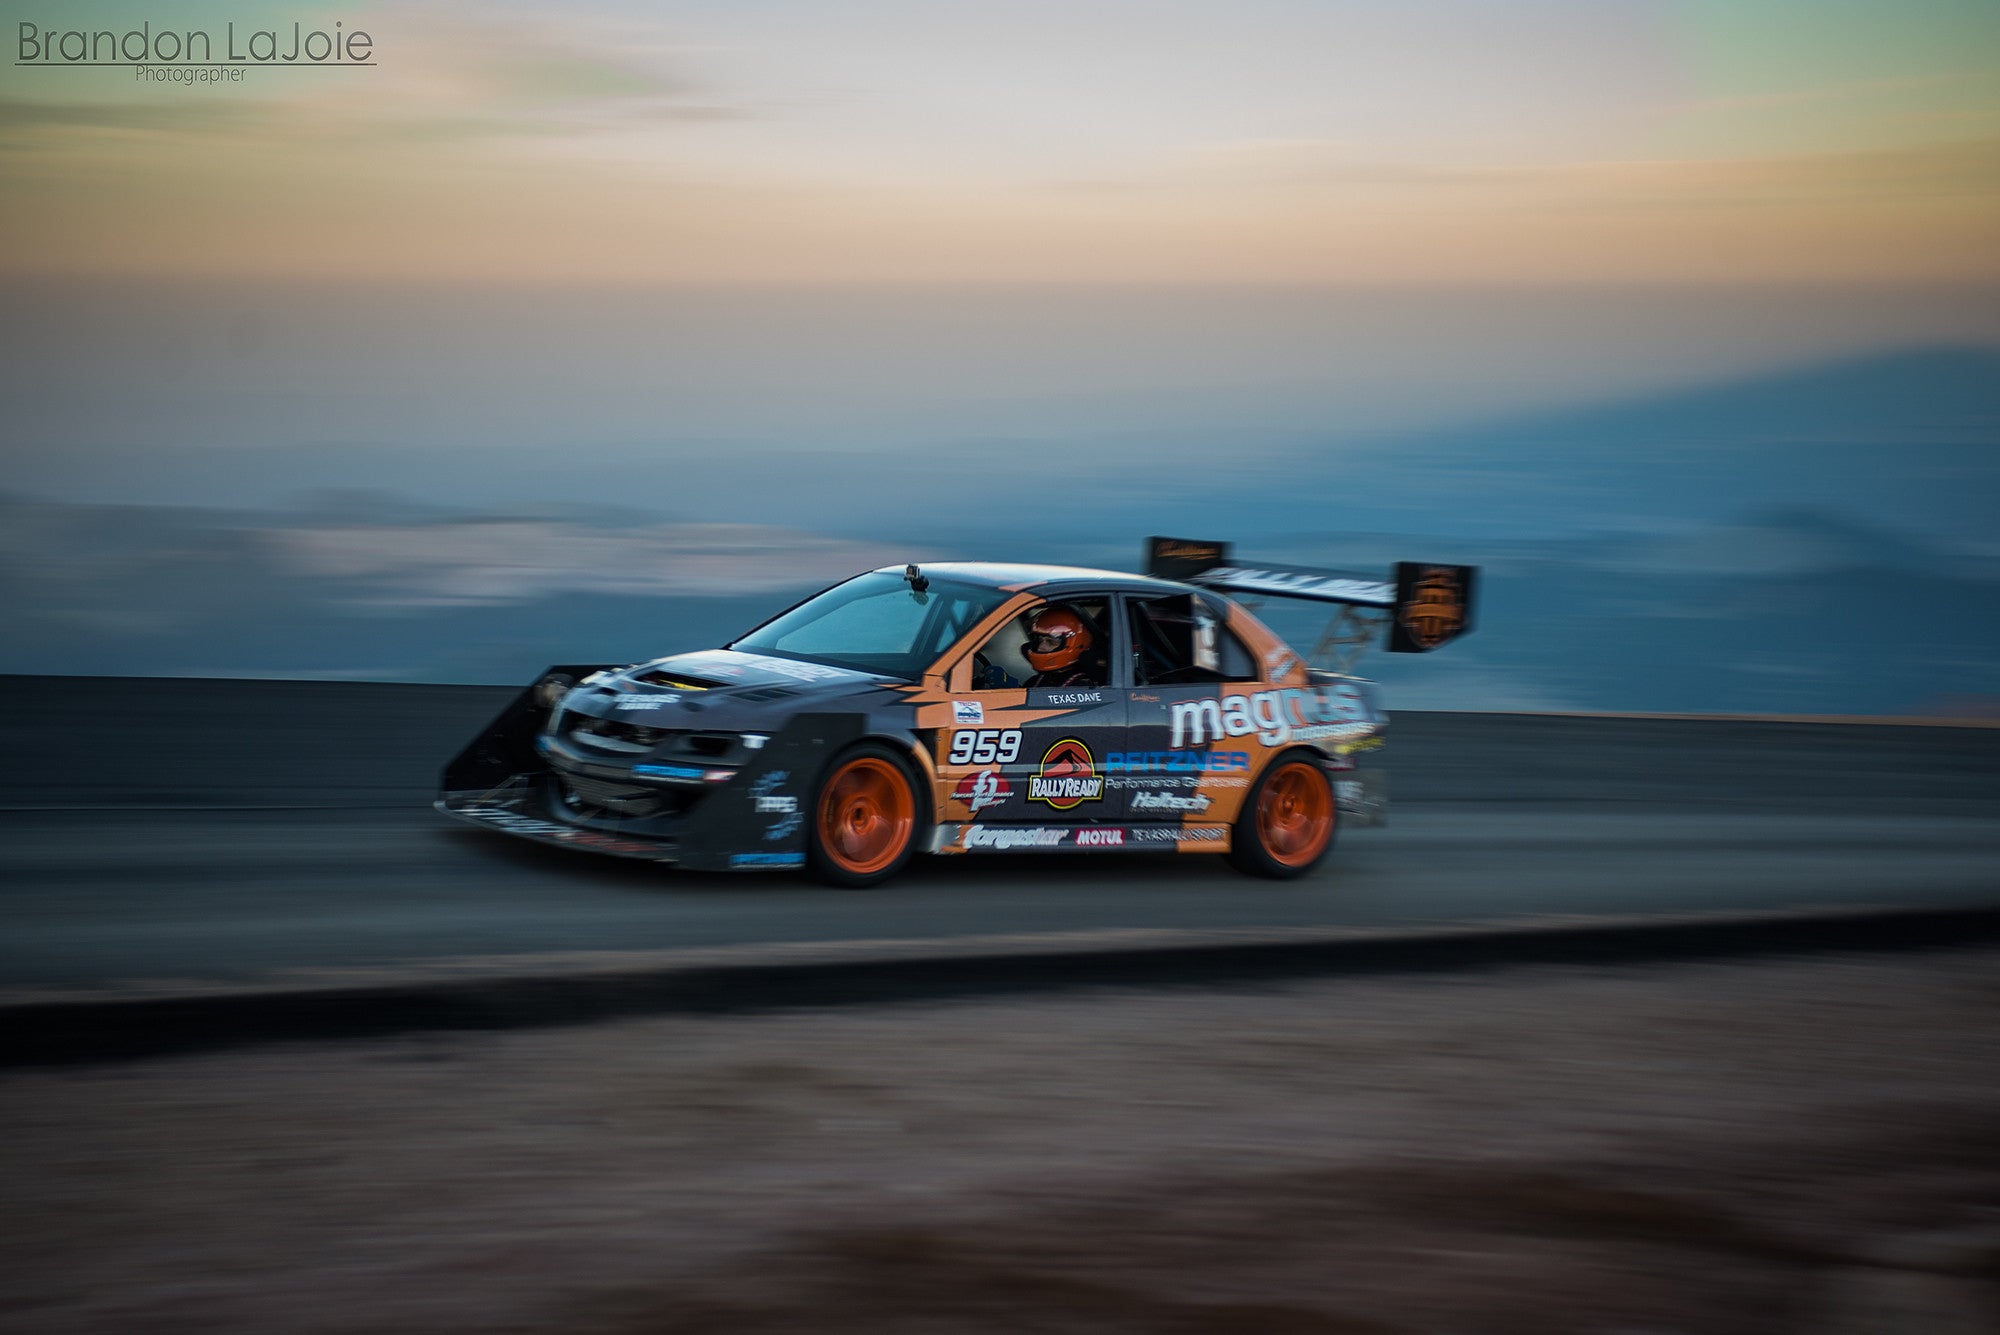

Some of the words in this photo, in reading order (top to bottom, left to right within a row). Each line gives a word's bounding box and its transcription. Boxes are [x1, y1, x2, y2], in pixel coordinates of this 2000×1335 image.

[1048, 693, 1077, 704] TEXAS
[1077, 692, 1102, 702] DAVE
[949, 729, 1023, 765] 959
[1105, 752, 1249, 773] PFITZNER
[1105, 777, 1181, 789] Performance
[1076, 830, 1124, 846] MOTUL
